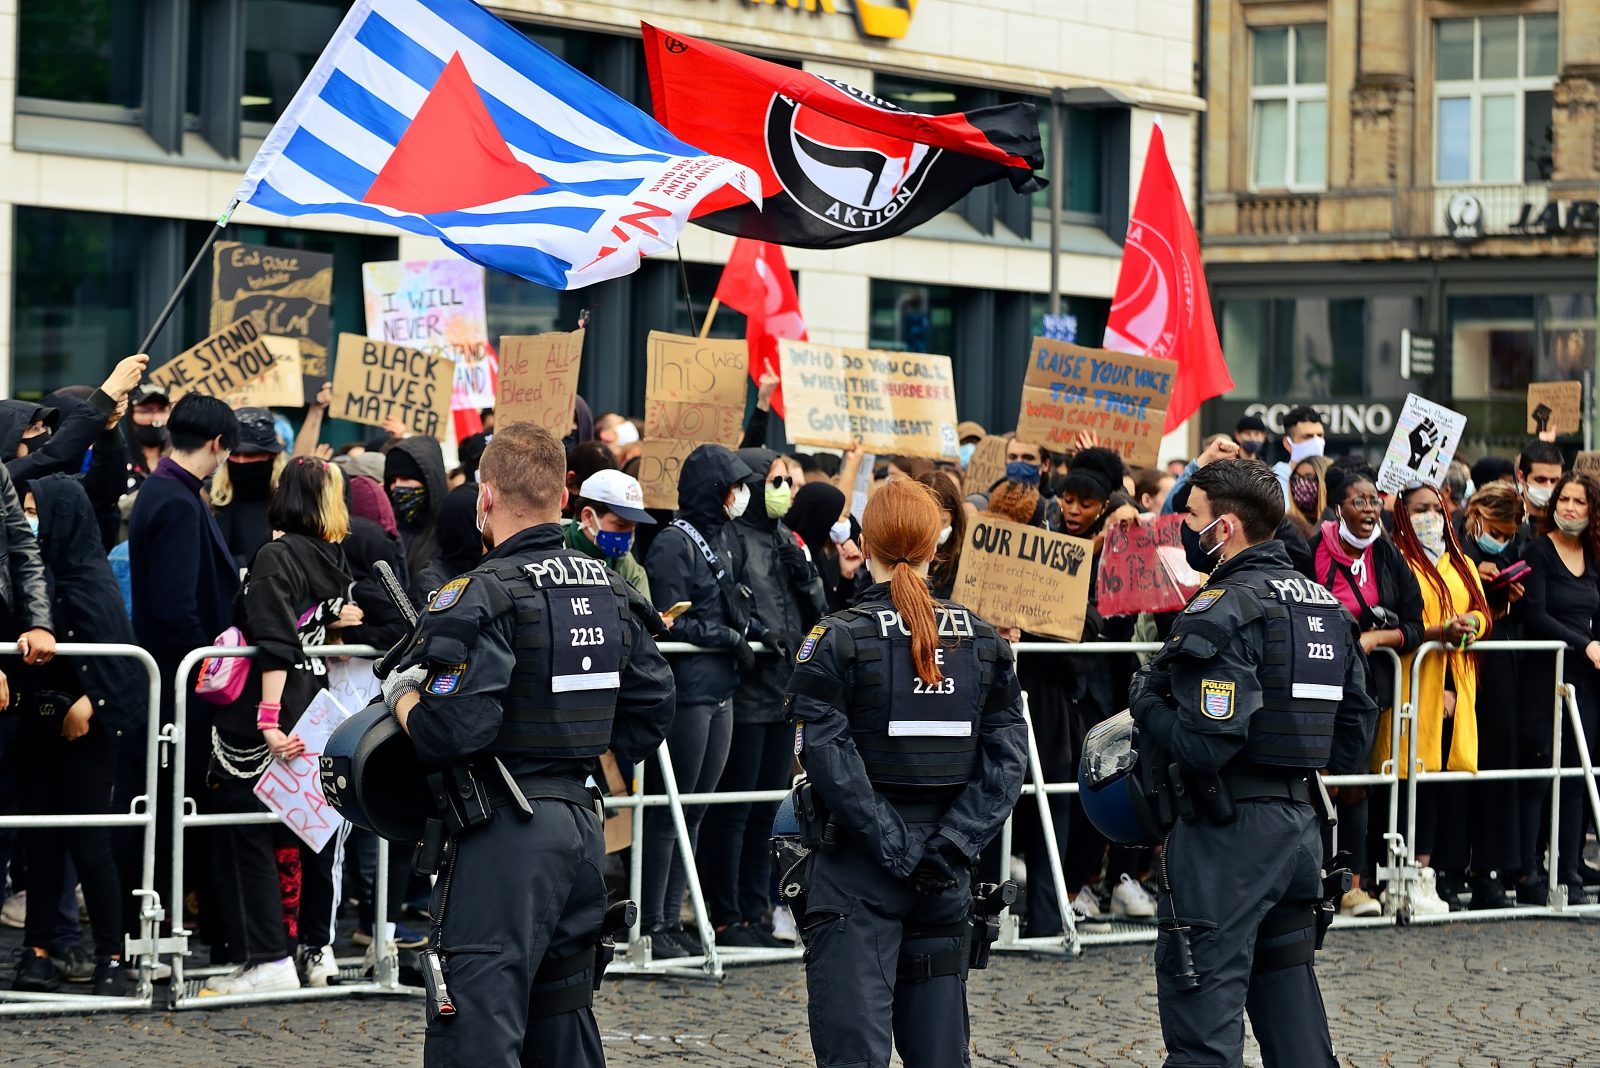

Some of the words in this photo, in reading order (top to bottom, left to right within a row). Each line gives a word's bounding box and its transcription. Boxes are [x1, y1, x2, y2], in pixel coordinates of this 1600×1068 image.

[648, 169, 677, 193] BUND
[674, 181, 698, 201] UND
[824, 186, 913, 227] AKTION
[381, 292, 399, 314] I
[406, 287, 464, 311] WILL
[382, 313, 443, 344] NEVER
[156, 359, 194, 391] WE
[193, 318, 260, 371] STAND
[229, 340, 275, 381] YOU
[362, 341, 440, 382] BLACK
[503, 342, 529, 378] We
[544, 342, 570, 371] ALL
[788, 347, 834, 370] WHO
[842, 354, 864, 370] DO
[867, 357, 899, 374] YOU
[902, 360, 949, 381] CALL
[1035, 347, 1088, 380] RAISE
[1090, 358, 1133, 388] YOUR
[366, 370, 437, 410] LIVES
[500, 379, 543, 405] Bleed
[799, 371, 848, 394] WHEN
[848, 377, 879, 394] THE
[883, 381, 952, 400] MURDERER
[1050, 381, 1088, 405] FOR
[1093, 386, 1153, 421] THOSE
[344, 391, 441, 438] MATTER
[833, 393, 849, 410] IS
[852, 394, 885, 412] THE
[1025, 400, 1065, 421] WHO
[1133, 419, 1152, 437] IT
[656, 402, 721, 439] NOT
[806, 406, 934, 436] GOVERNMENT
[971, 522, 1013, 558] OUR
[1017, 532, 1074, 572] LIVES
[523, 556, 611, 587] POLIZEI
[993, 558, 1004, 573] to
[570, 597, 593, 616] HE
[991, 594, 1013, 614] that
[570, 627, 605, 647] 2213
[1307, 615, 1326, 633] HE
[1306, 642, 1335, 661] 2213
[256, 750, 321, 812] FUCK
[319, 755, 343, 808] 2213
